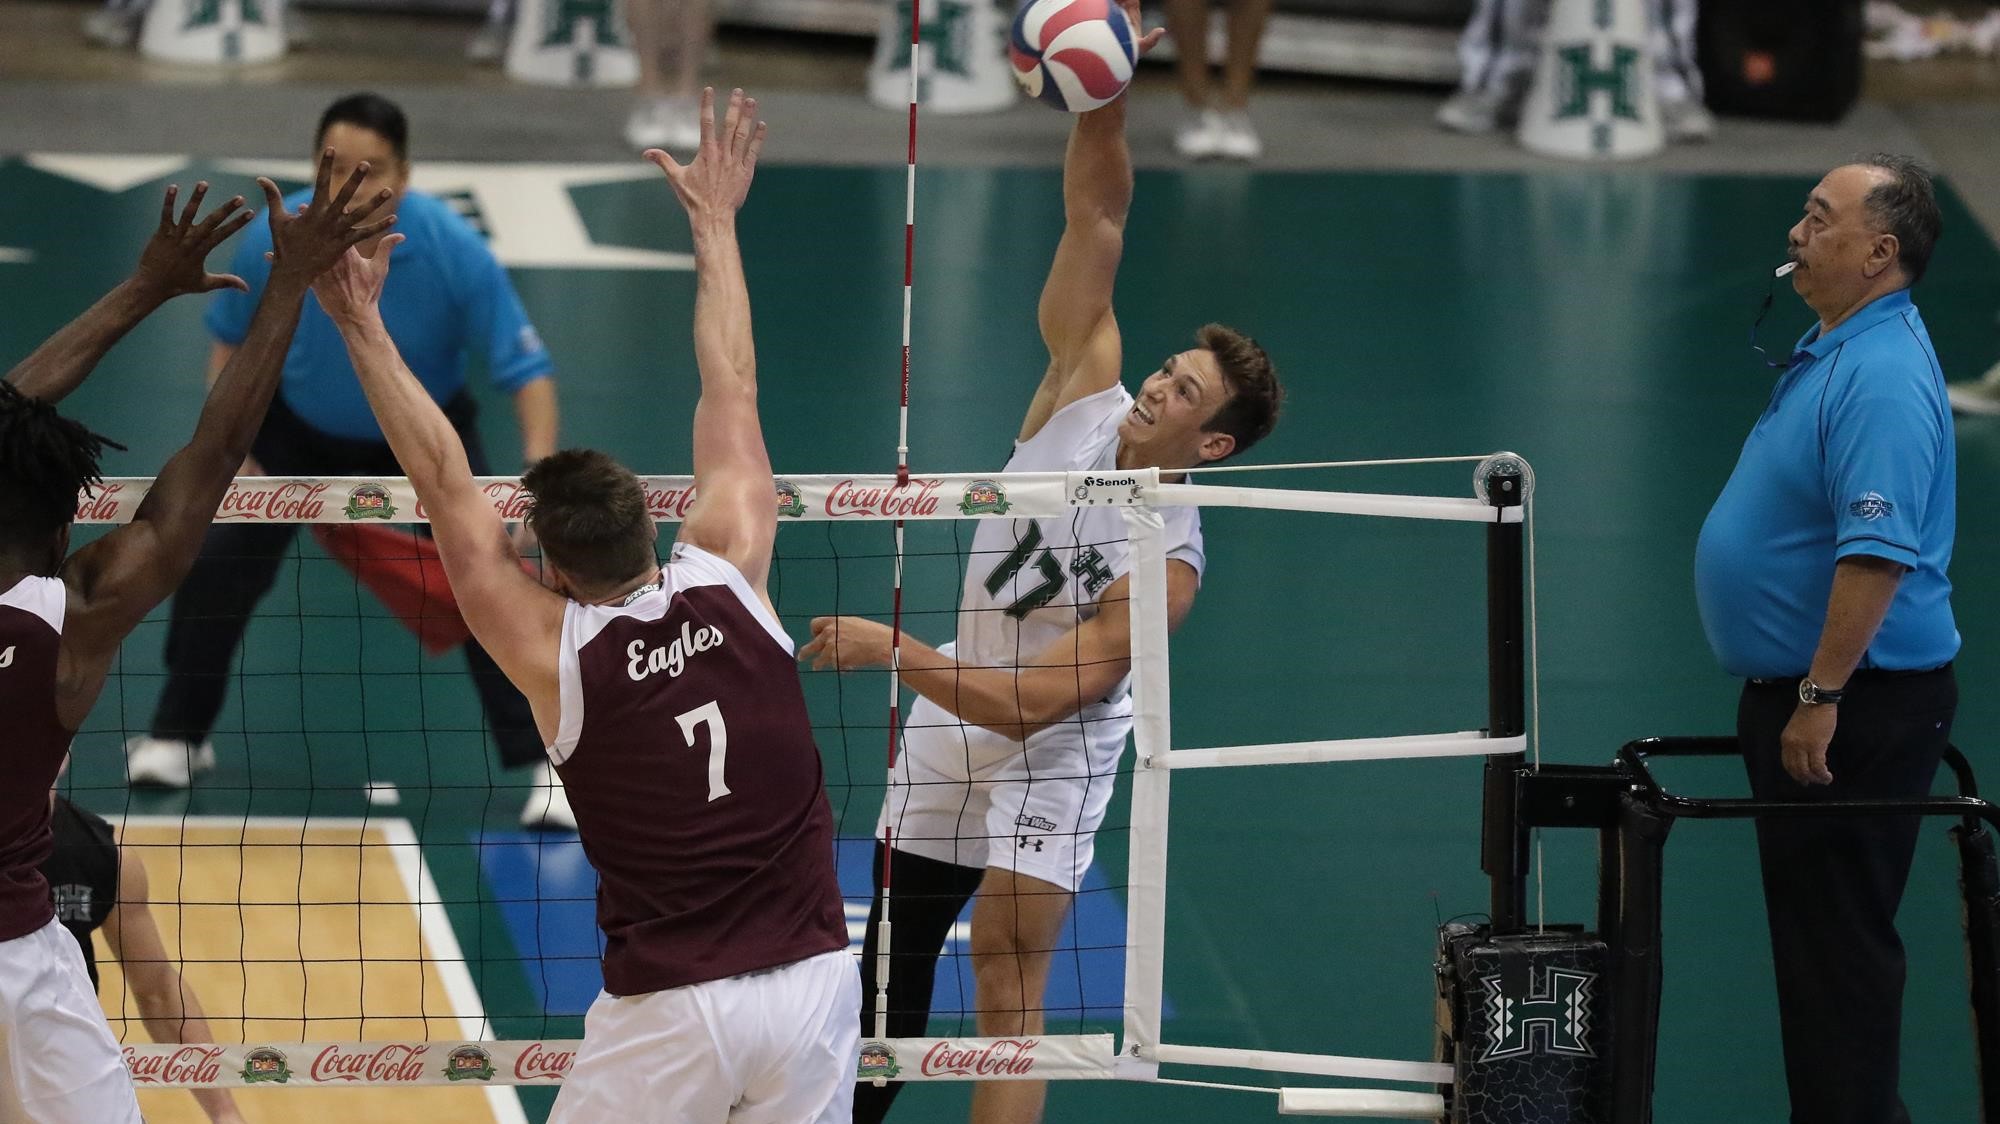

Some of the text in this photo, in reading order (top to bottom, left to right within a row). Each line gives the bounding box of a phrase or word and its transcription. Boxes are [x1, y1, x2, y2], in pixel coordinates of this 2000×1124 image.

[777, 492, 793, 507] ole
[825, 479, 945, 517] Coca-Cola
[971, 490, 998, 505] Dole
[1096, 477, 1136, 487] Senoh
[357, 495, 383, 508] Dole
[984, 518, 1068, 621] 17
[627, 620, 724, 681] Eagles
[674, 700, 732, 802] 7
[122, 1046, 227, 1083] oca-Cola
[310, 1044, 430, 1081] Coca-Cola
[456, 1056, 482, 1069] Dole
[862, 1054, 888, 1067] Dole
[921, 1039, 1041, 1077] Coca-Cola
